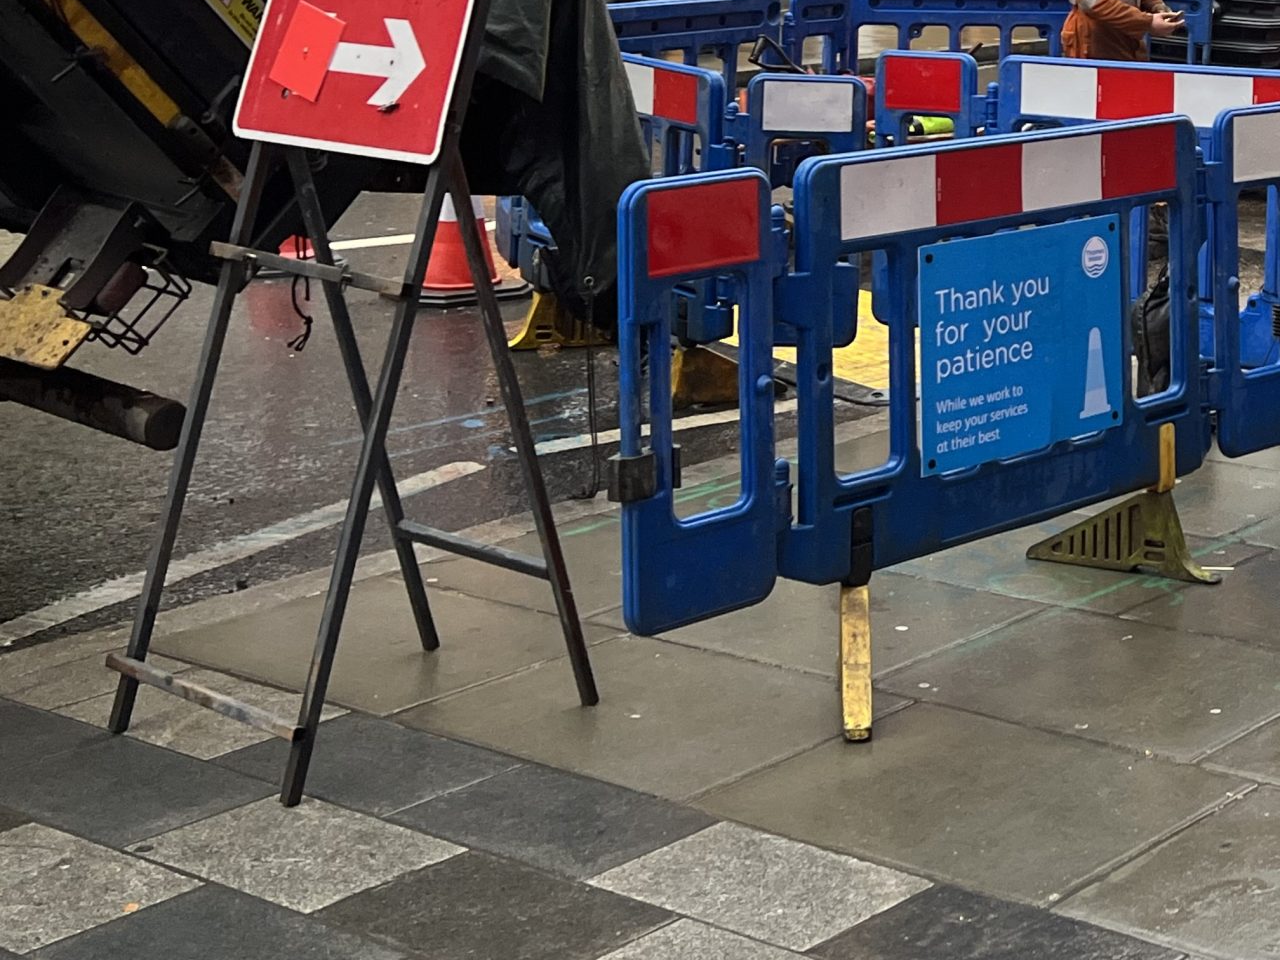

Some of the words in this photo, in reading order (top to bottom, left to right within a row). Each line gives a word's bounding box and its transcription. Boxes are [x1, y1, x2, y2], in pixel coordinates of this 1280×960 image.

[935, 280, 1004, 315] Thank
[1011, 276, 1050, 307] you
[936, 320, 969, 347] for
[983, 309, 1033, 342] your
[936, 341, 1033, 383] patience
[936, 396, 967, 414] While
[969, 394, 985, 407] we
[986, 385, 1011, 403] work
[1012, 385, 1024, 397] to
[936, 419, 962, 434] keep
[964, 412, 988, 431] your
[990, 403, 1029, 422] services
[936, 440, 949, 454] at
[951, 434, 976, 451] their
[978, 428, 1001, 444] best
